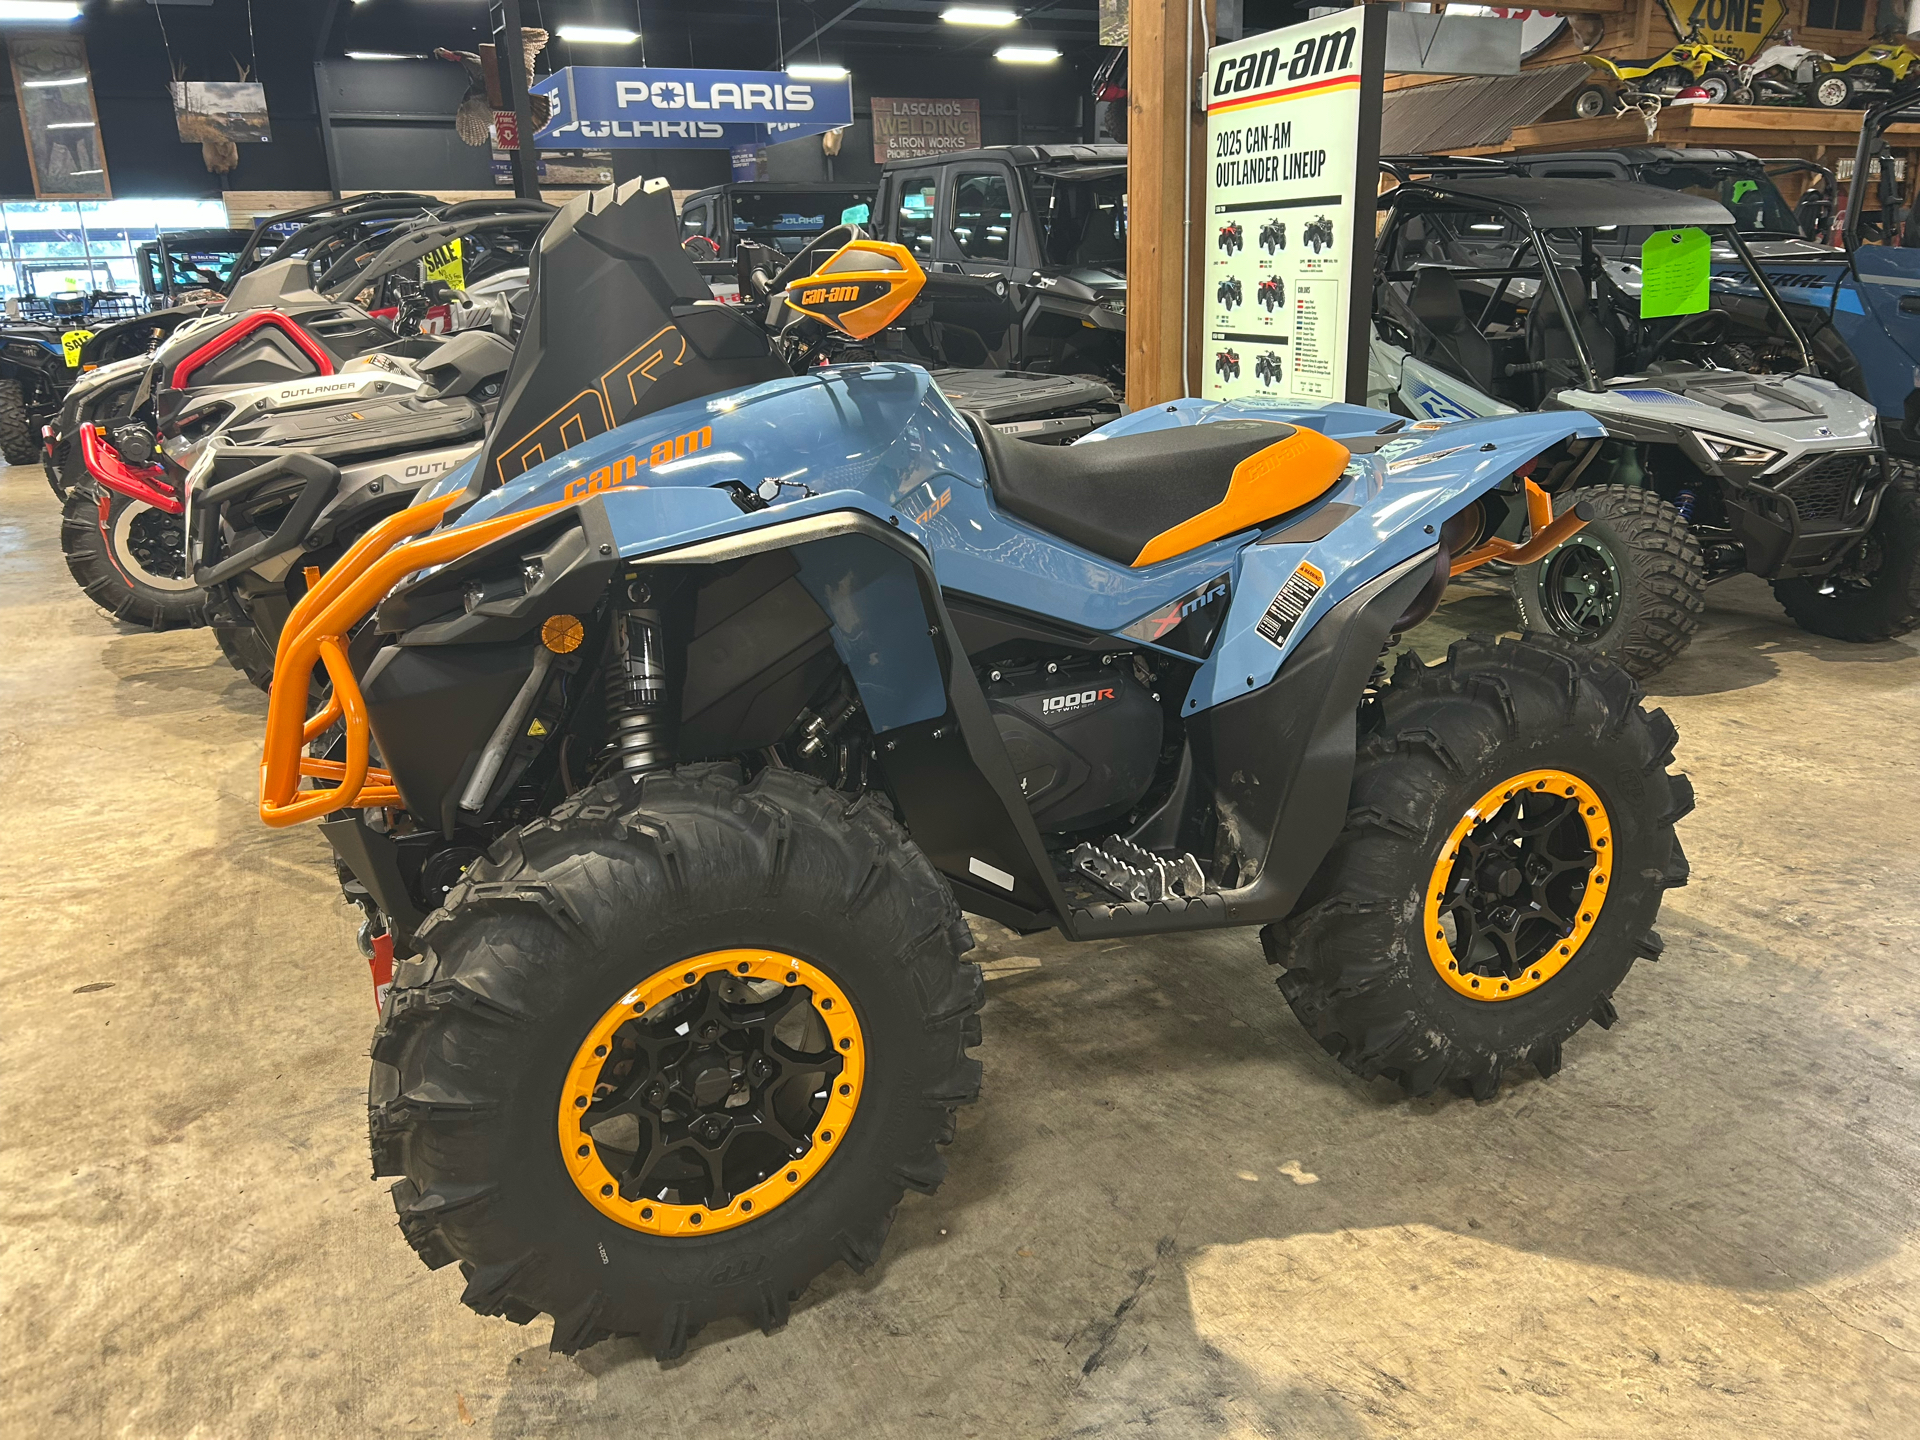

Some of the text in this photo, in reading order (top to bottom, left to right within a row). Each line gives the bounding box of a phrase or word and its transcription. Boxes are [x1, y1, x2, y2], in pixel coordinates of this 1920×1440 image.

[616, 81, 815, 111] POLARIS
[893, 101, 961, 116] LASCARO'S
[879, 117, 972, 136] WELDING
[899, 137, 925, 148] IRON
[928, 137, 966, 148] WORKS
[1217, 121, 1292, 158] 2025 CAN-AM
[887, 149, 910, 159] PHONE
[1216, 150, 1326, 188] OUTLANDER LINEUP
[424, 242, 459, 273] SALE
[802, 286, 859, 305] can-am
[564, 425, 712, 500] can-am
[1042, 688, 1115, 712] 1000R
[1043, 705, 1080, 715] V-TWIN
